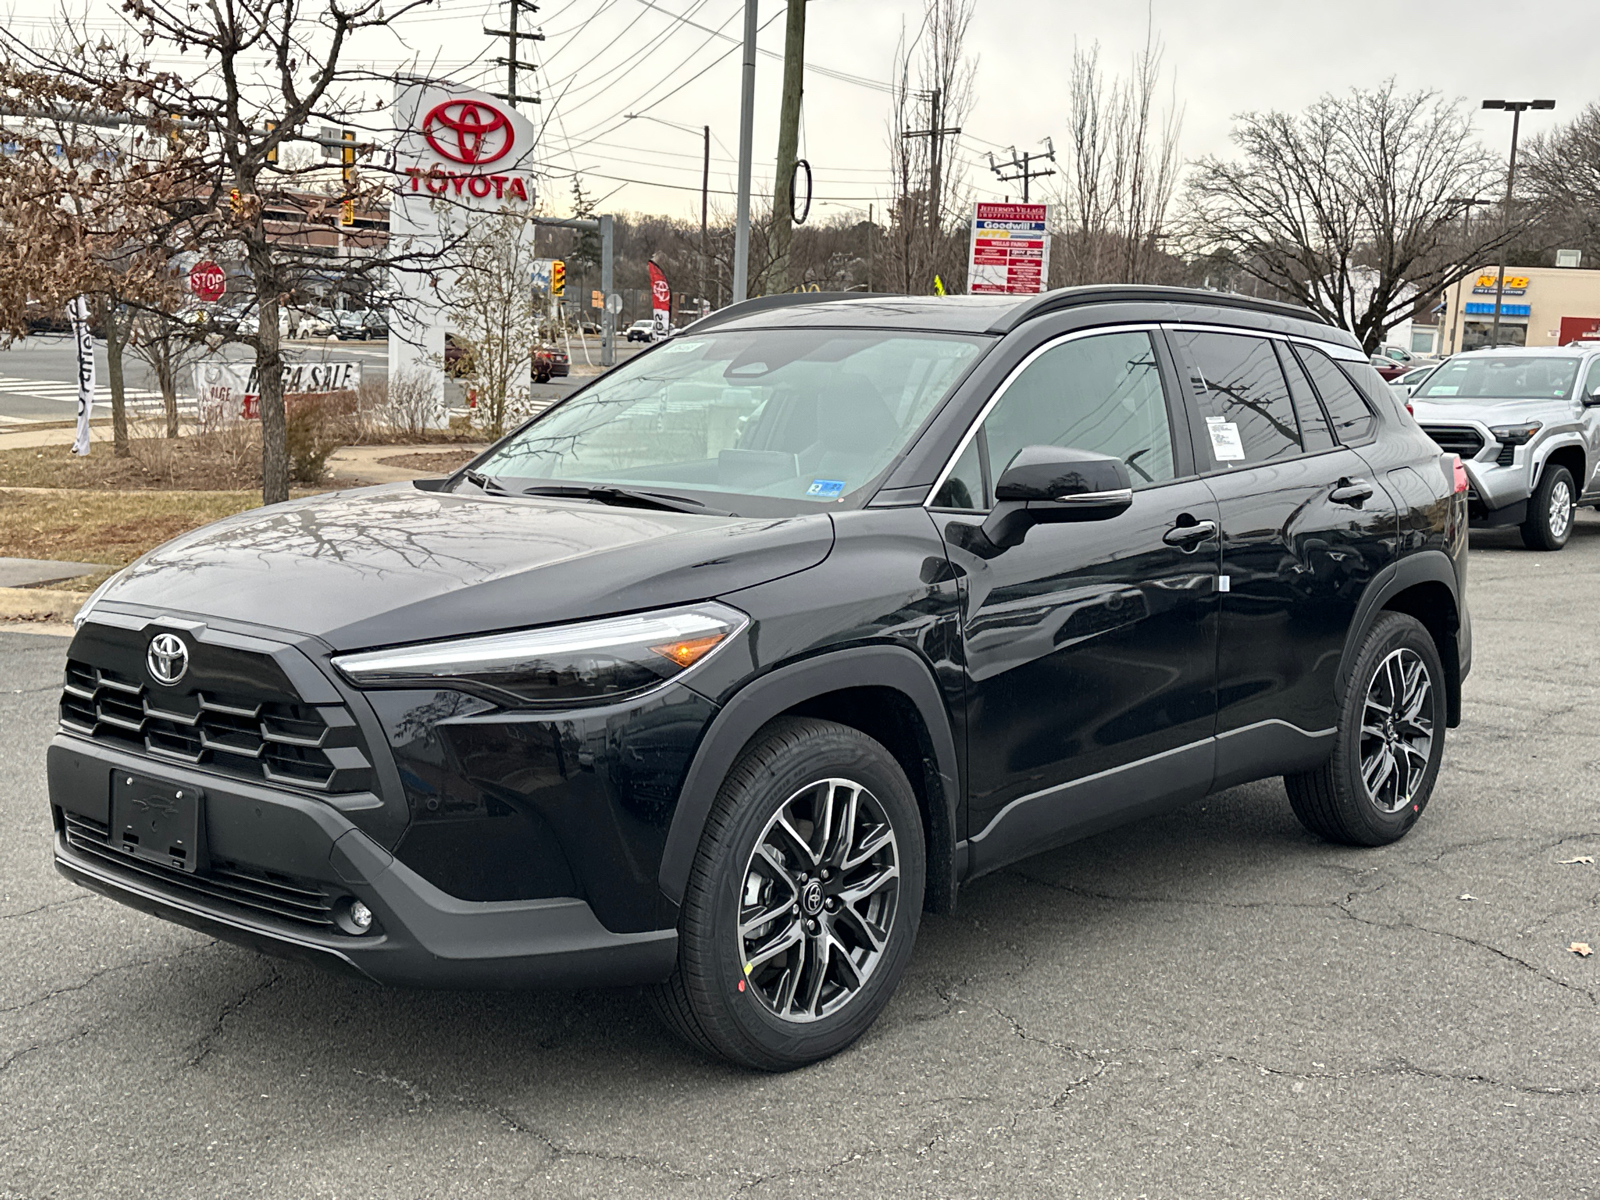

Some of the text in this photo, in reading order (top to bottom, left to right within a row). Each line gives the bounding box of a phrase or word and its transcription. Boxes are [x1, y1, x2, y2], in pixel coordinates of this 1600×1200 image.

[405, 167, 528, 201] TOYOTA
[984, 222, 1030, 230] Goodwill
[193, 272, 224, 290] STOP
[1474, 275, 1530, 288] NTB
[245, 364, 354, 393] MGA SALE
